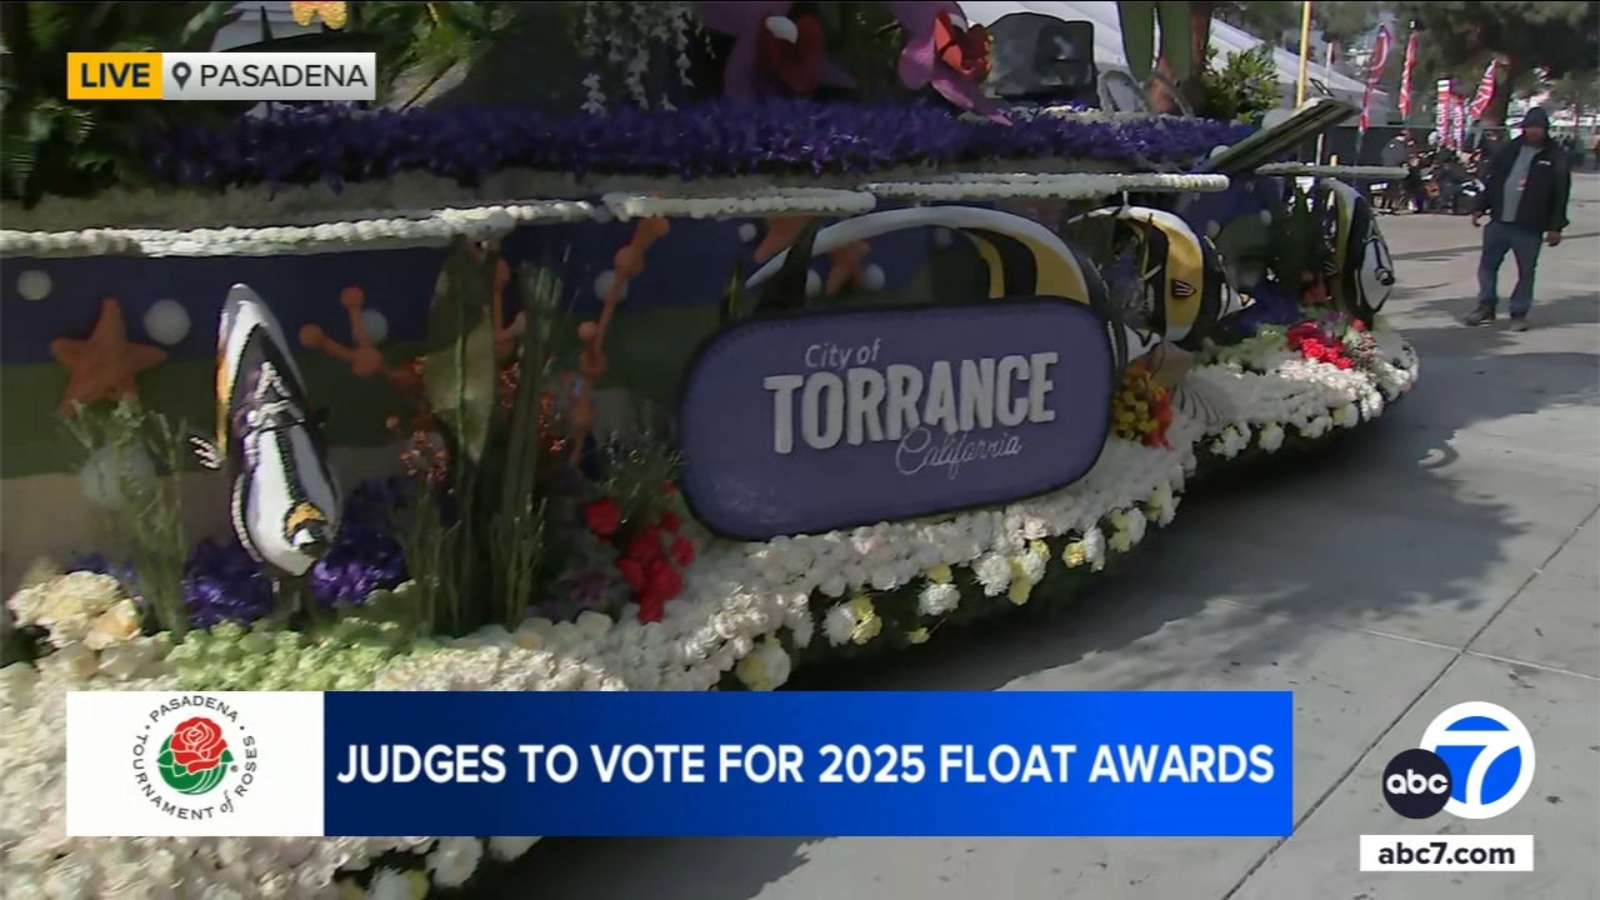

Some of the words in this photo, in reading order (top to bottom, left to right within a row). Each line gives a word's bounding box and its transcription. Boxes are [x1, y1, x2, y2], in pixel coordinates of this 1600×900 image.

[804, 343, 853, 369] City
[856, 337, 882, 362] of
[763, 351, 1059, 454] TORRANCE
[895, 426, 1024, 480] California
